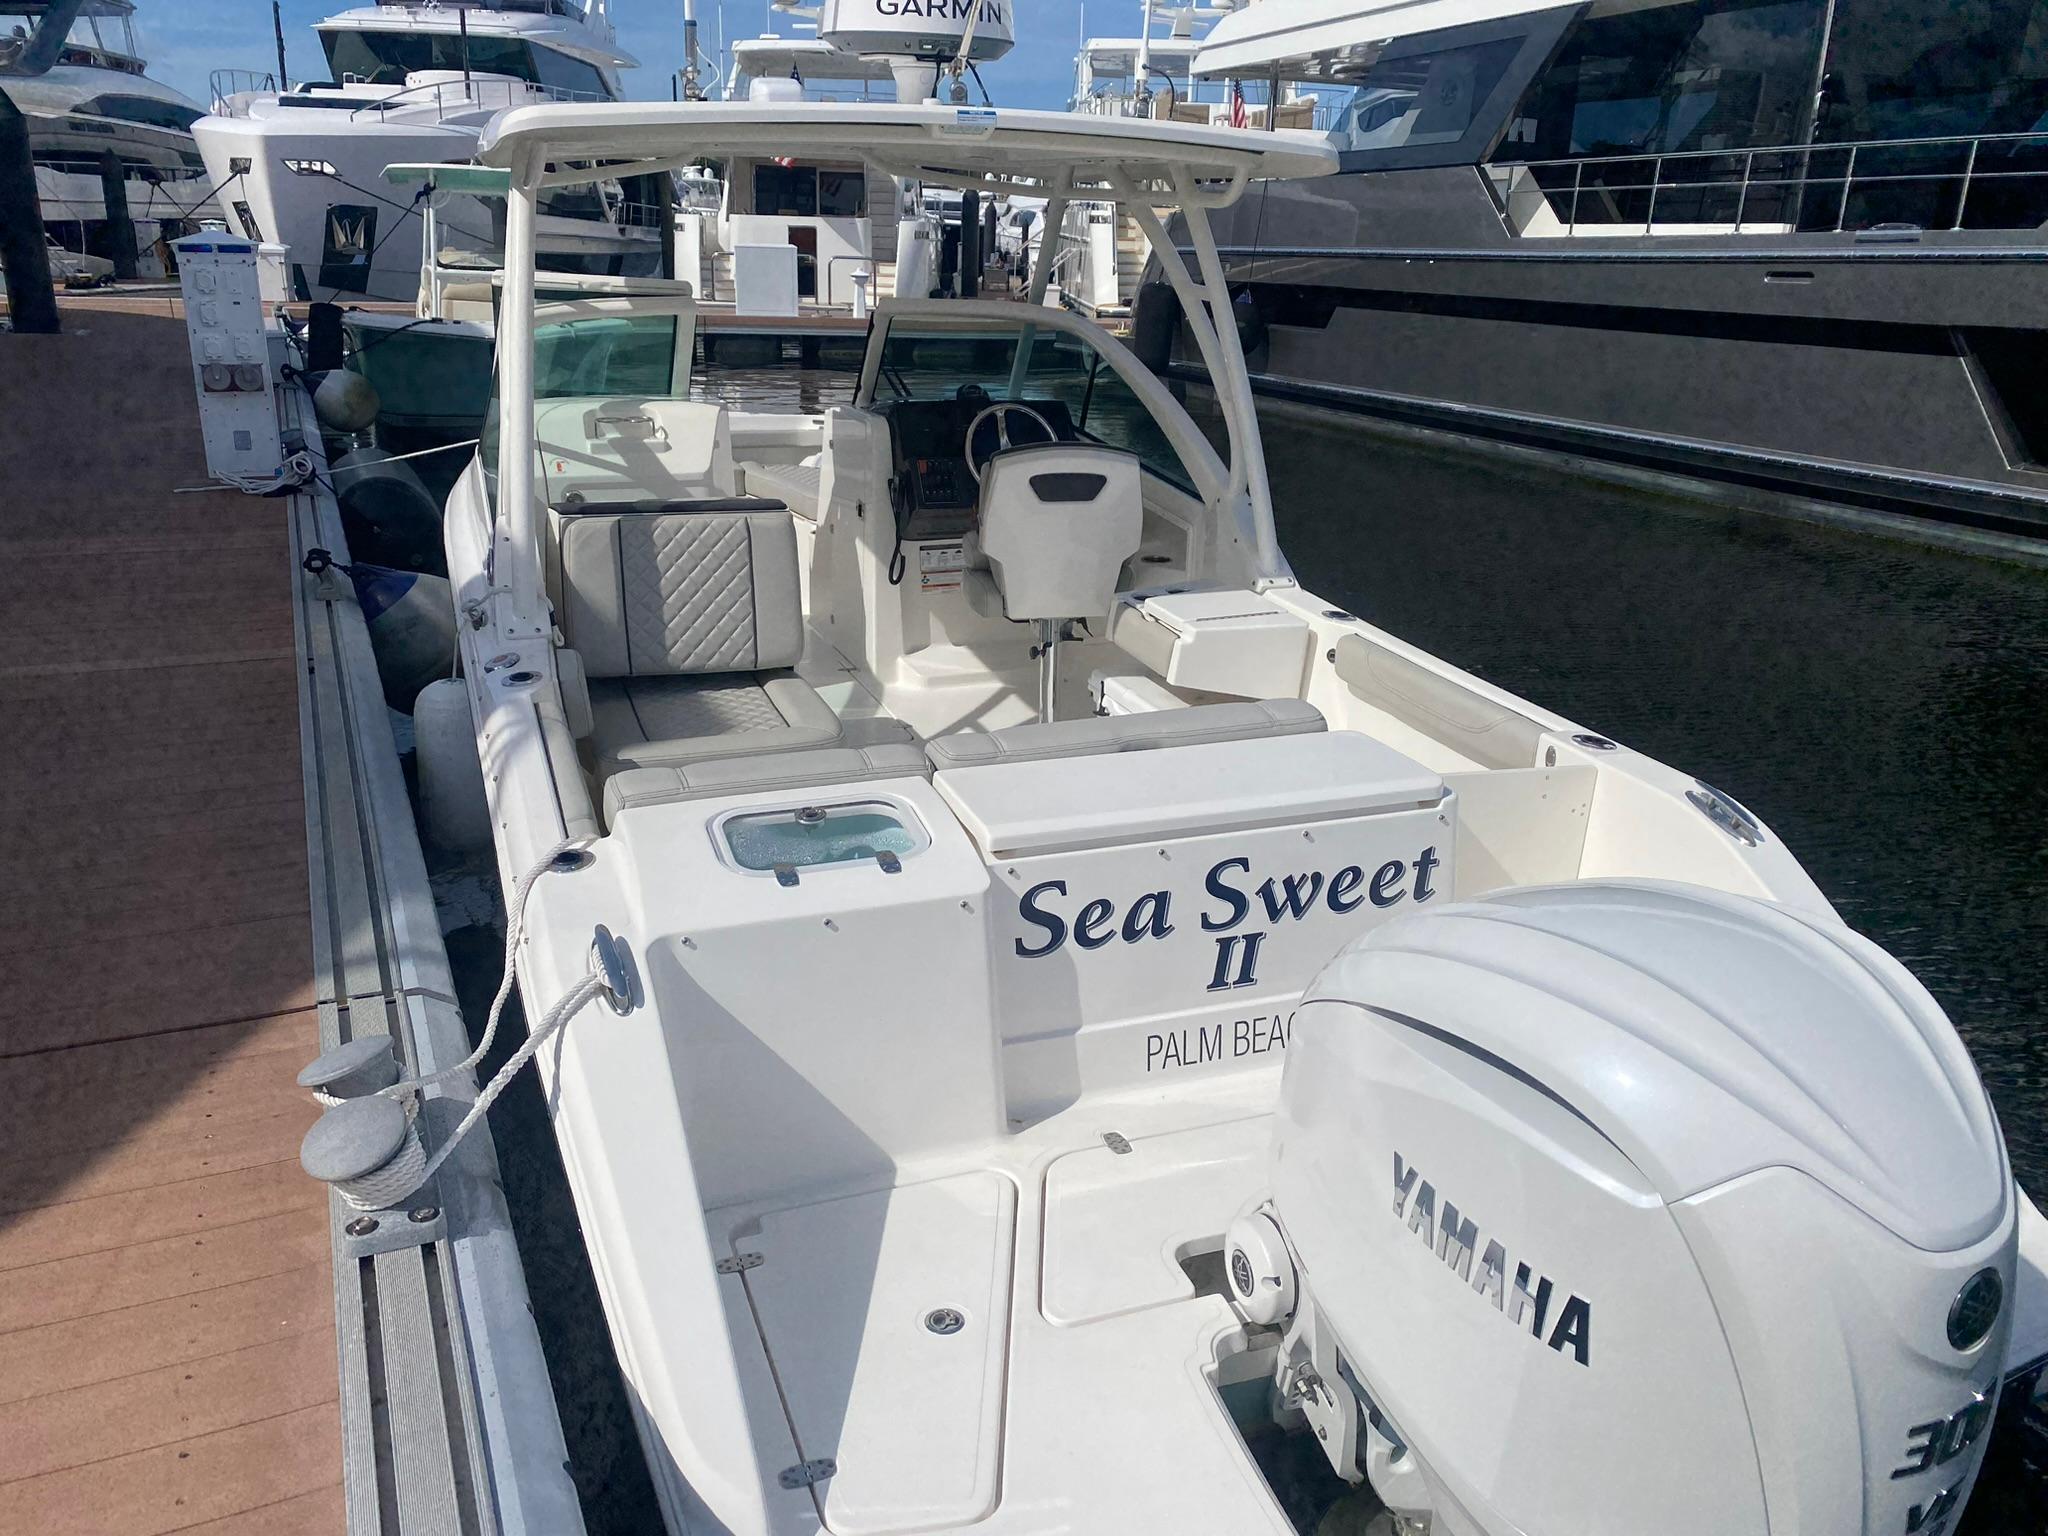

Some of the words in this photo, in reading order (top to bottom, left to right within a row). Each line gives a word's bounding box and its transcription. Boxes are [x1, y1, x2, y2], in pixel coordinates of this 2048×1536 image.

[876, 0, 1002, 25] GARMIN
[1015, 880, 1175, 958] Sea
[1201, 845, 1440, 933] Sweet
[1206, 932, 1267, 993] II
[1147, 1024, 1222, 1072] PALM
[1393, 1150, 1592, 1368] YAMAHA
